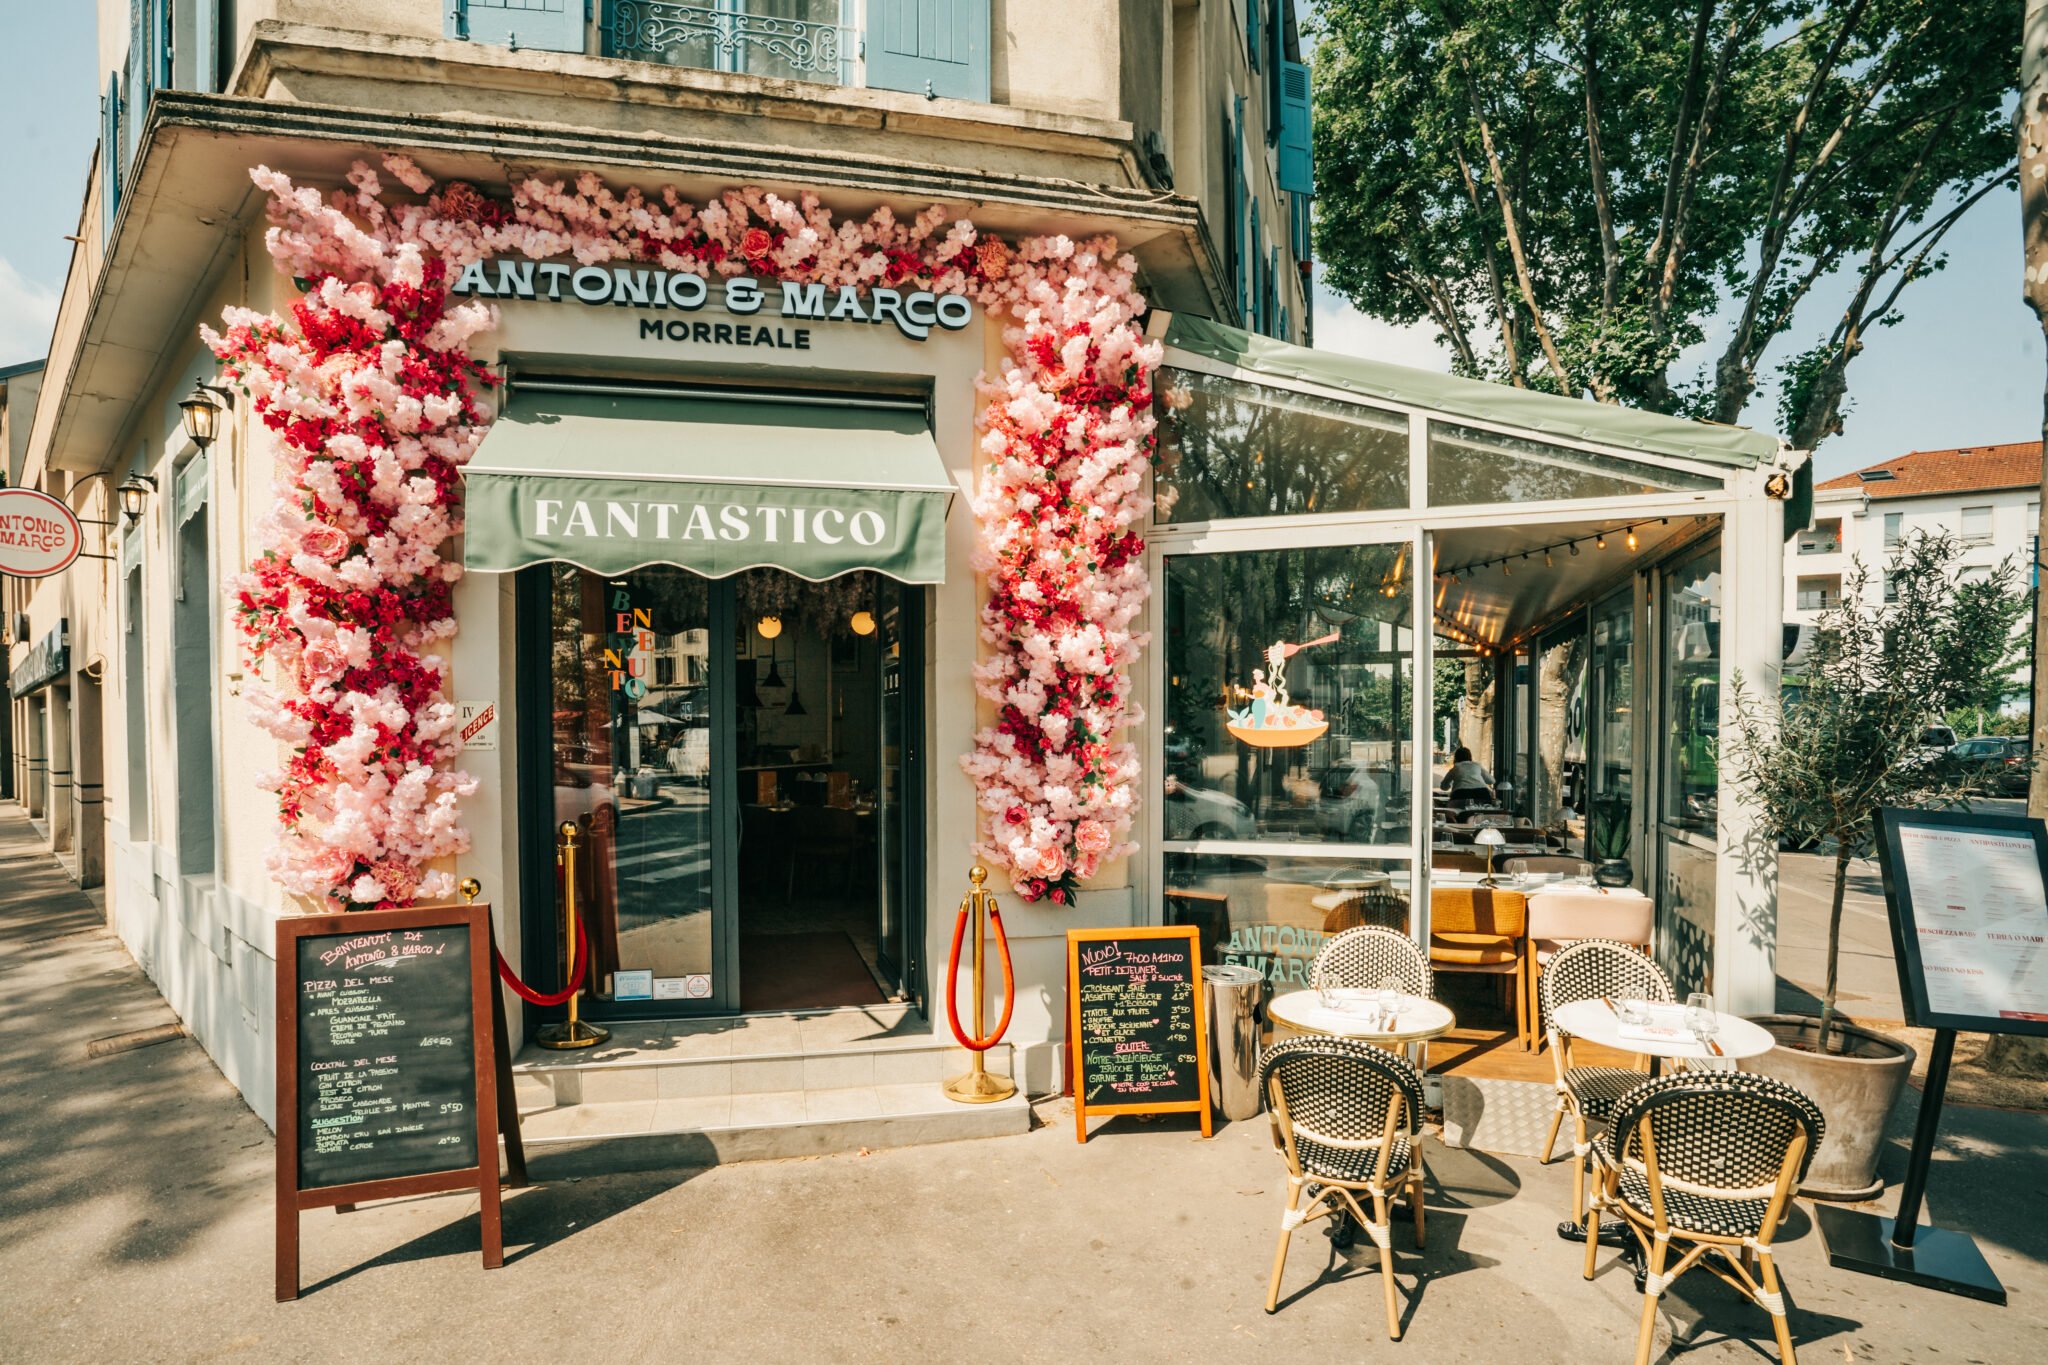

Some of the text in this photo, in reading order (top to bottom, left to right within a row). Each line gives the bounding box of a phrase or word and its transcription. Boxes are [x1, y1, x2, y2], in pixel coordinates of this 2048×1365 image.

[452, 259, 972, 341] ANTONIO & MARCO
[640, 319, 810, 349] MORREALE
[0, 515, 65, 535] NTONIO
[534, 499, 886, 546] FANTASTICO
[0, 531, 66, 552] MARCO
[462, 706, 474, 719] IV
[404, 931, 423, 941] DA
[345, 945, 433, 969] ANTONIO & MARCO
[1082, 941, 1122, 965] NUOVO!
[1123, 952, 1150, 964] 7h00
[304, 976, 394, 990] PIZZA DEL MESE
[1083, 983, 1125, 993] CROISSANT
[332, 996, 381, 1006] MOZZARELLA
[317, 1007, 339, 1016] APRES
[330, 1015, 371, 1024] GUANCIALE
[310, 1056, 397, 1071] COCKTAIL DEL MESE
[1087, 1050, 1112, 1065] NOTRE
[1099, 1064, 1133, 1073] BRIOCHE
[318, 1072, 340, 1082] FRUIT
[357, 1084, 383, 1093] CITRON
[402, 1101, 430, 1111] MENTHE
[440, 1103, 463, 1114] 9€50
[311, 1115, 364, 1128] SUGGESTION
[317, 1127, 342, 1135] MELON
